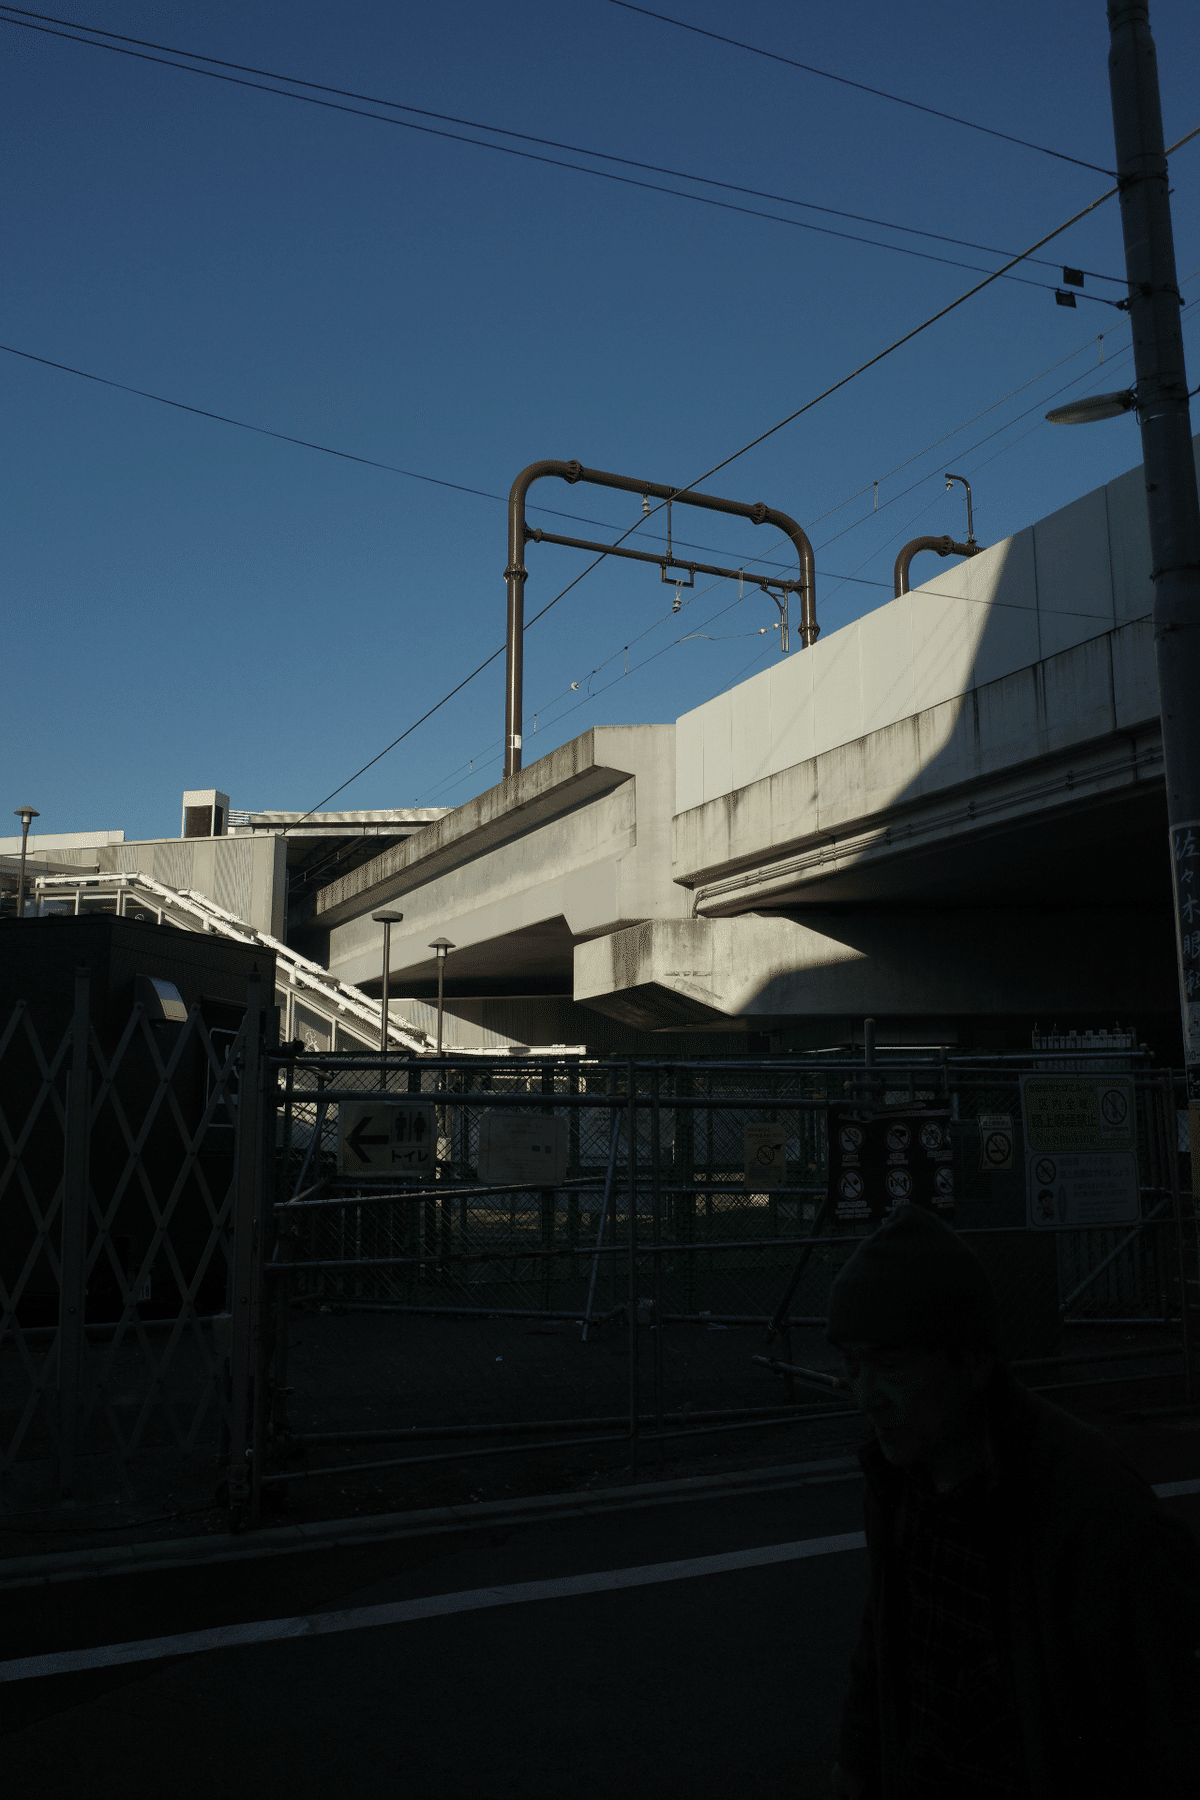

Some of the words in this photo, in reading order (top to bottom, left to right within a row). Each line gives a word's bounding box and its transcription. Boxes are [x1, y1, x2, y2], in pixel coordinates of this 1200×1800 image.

[1031, 1114, 1097, 1128] 路上喫煙禁止
[1036, 1133, 1050, 1144] No
[1053, 1132, 1097, 1145] Smoking
[391, 1150, 429, 1163] トイレ
